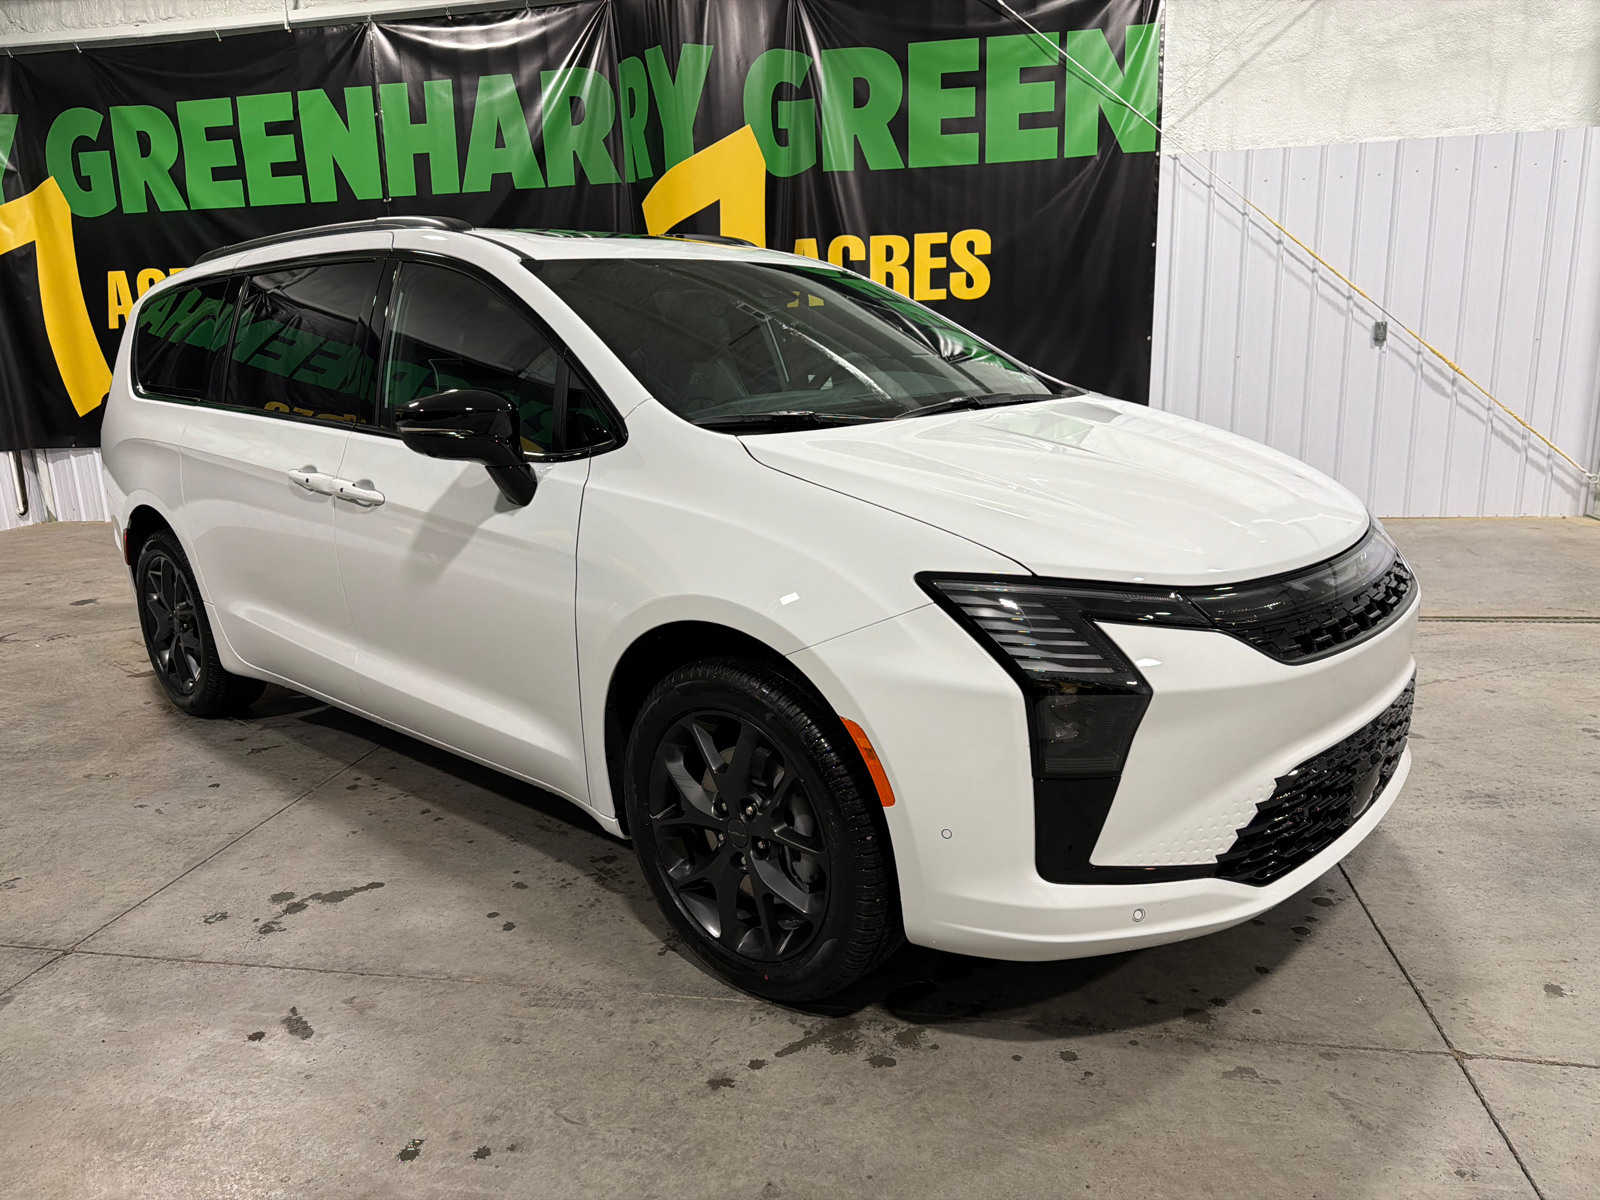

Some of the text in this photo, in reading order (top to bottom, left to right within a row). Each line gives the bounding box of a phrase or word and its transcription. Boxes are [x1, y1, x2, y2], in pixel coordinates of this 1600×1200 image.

[46, 86, 385, 218] GREEN
[378, 22, 1160, 199] HARRY GREEN
